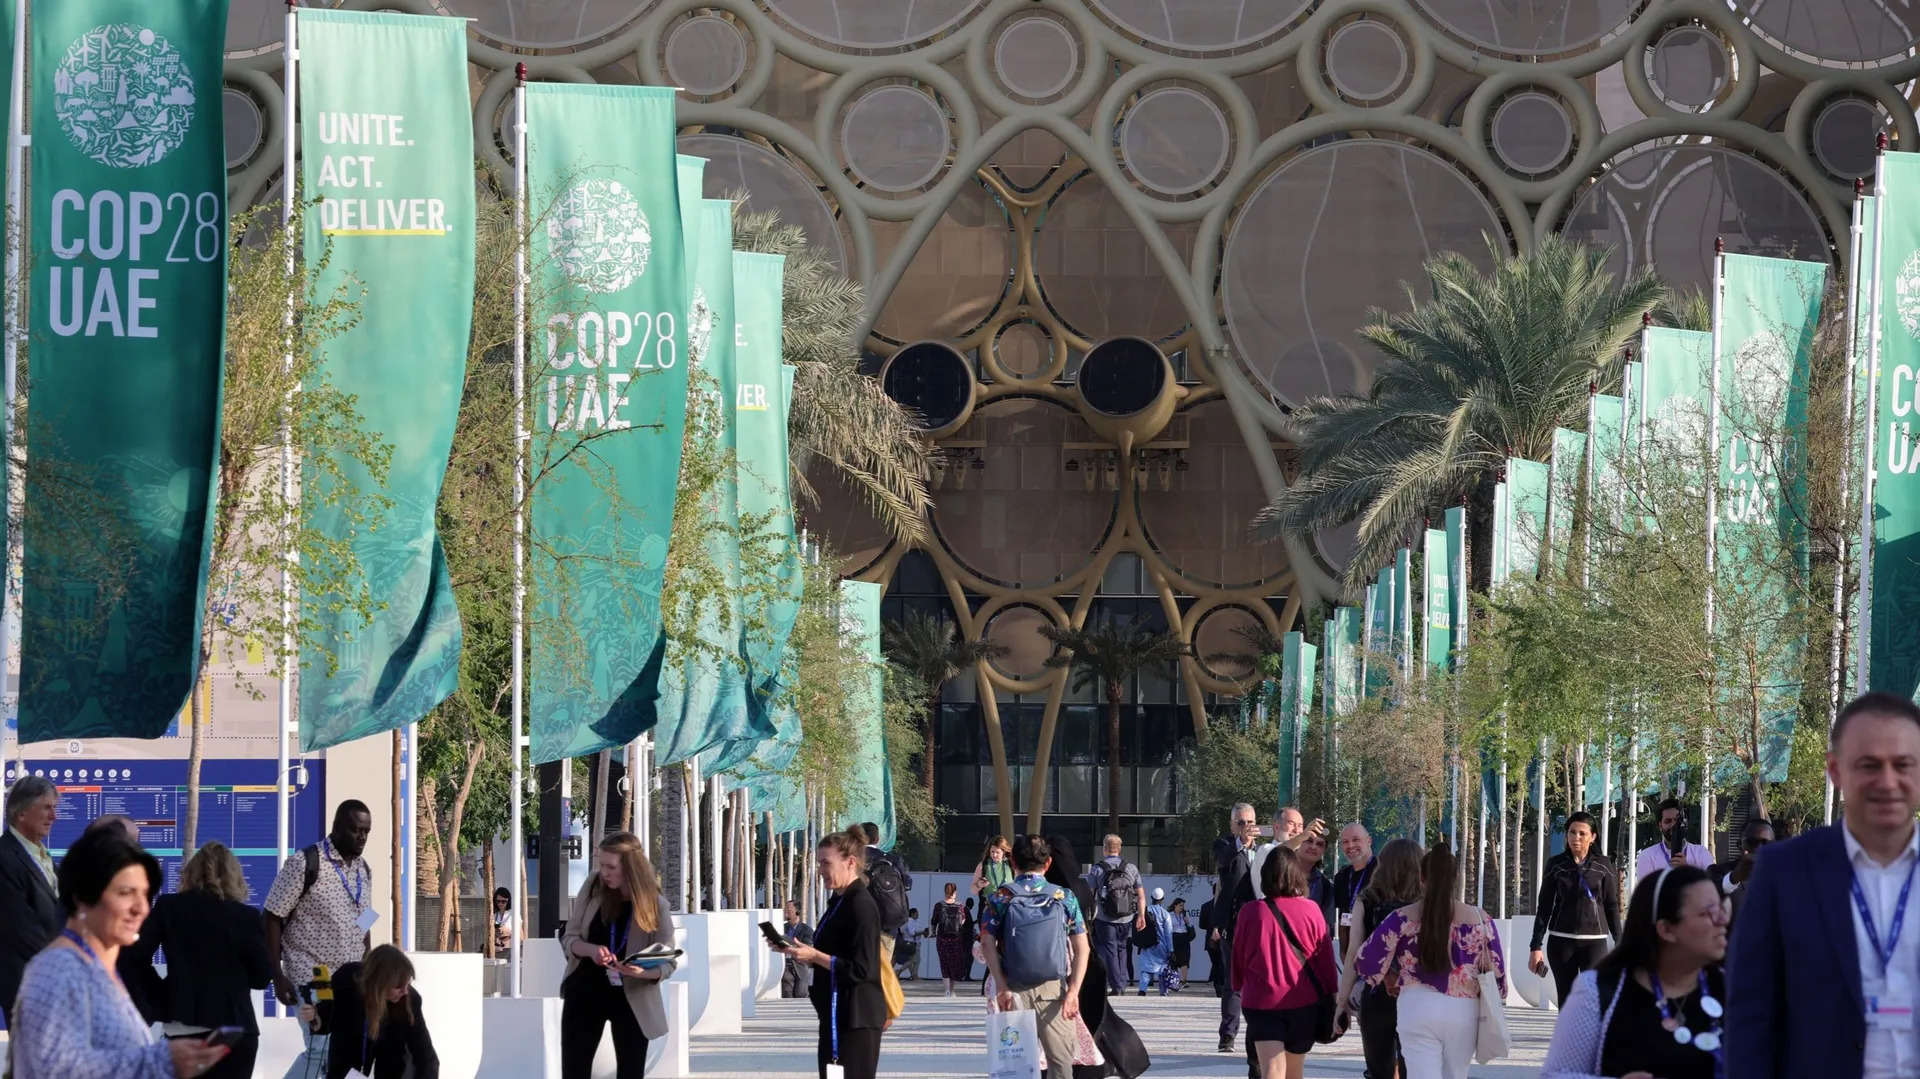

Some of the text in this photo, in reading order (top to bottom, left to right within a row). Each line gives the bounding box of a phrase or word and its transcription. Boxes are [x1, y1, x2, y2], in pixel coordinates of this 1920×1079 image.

[319, 111, 415, 146] UNITE.
[317, 155, 383, 188] ACT.
[51, 188, 220, 263] COP28
[320, 198, 453, 232] DELIVER.
[49, 266, 160, 338] UAE
[547, 311, 676, 371] COP28
[546, 373, 632, 432] UAE
